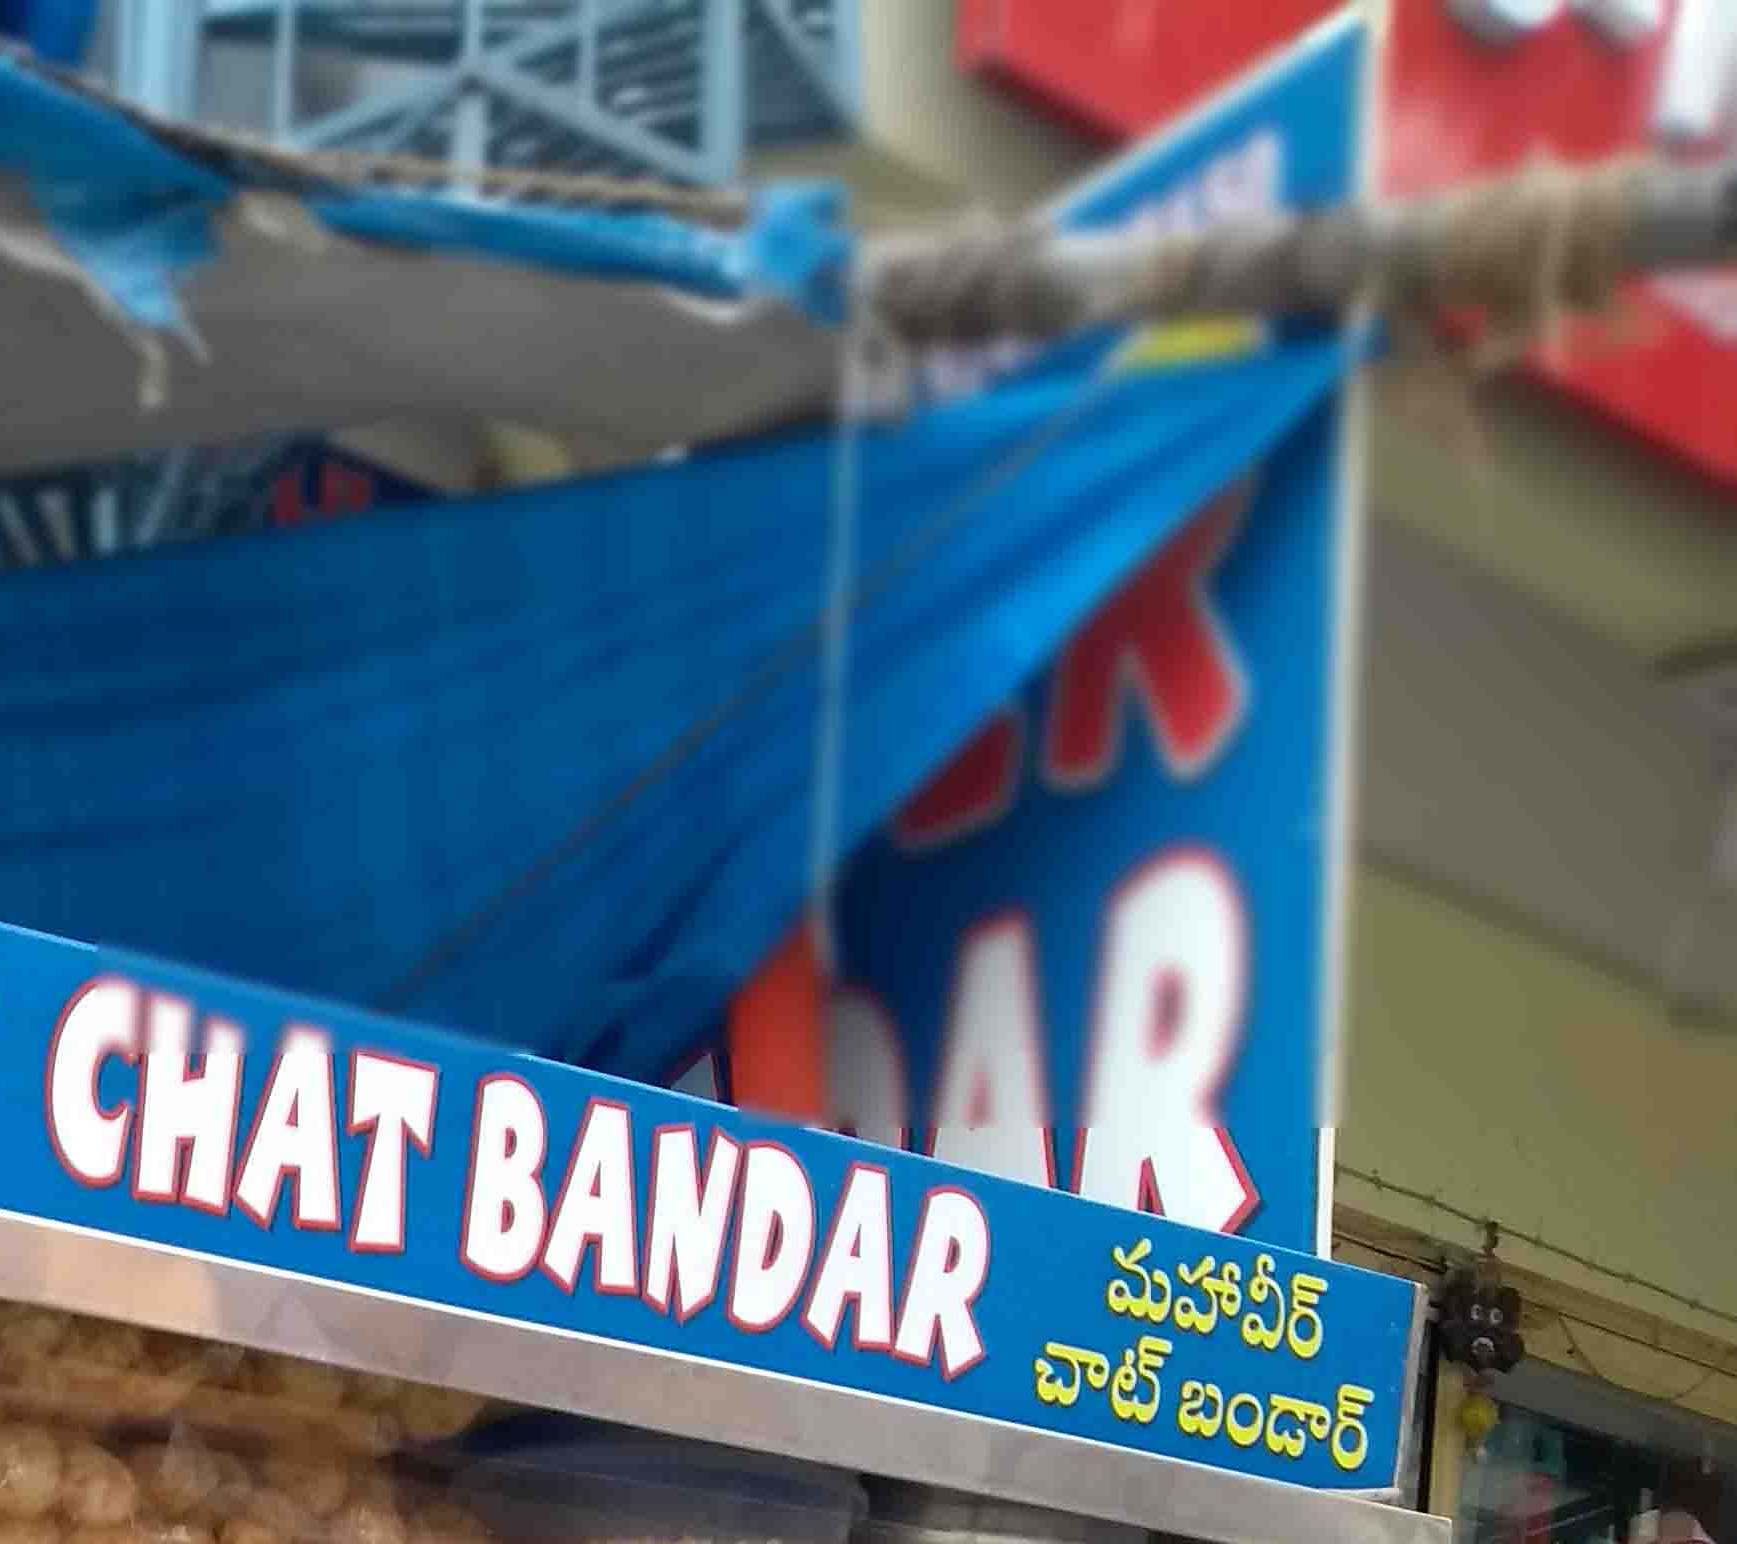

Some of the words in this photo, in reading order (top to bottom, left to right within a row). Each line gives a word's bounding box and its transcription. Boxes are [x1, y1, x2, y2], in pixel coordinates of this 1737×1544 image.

[46, 976, 441, 1254] CHAT
[460, 1072, 991, 1381] BANDAR
[1106, 1237, 1329, 1360] మహావీర్
[1032, 1334, 1173, 1424] చాట్
[1176, 1379, 1375, 1471] బండార్
